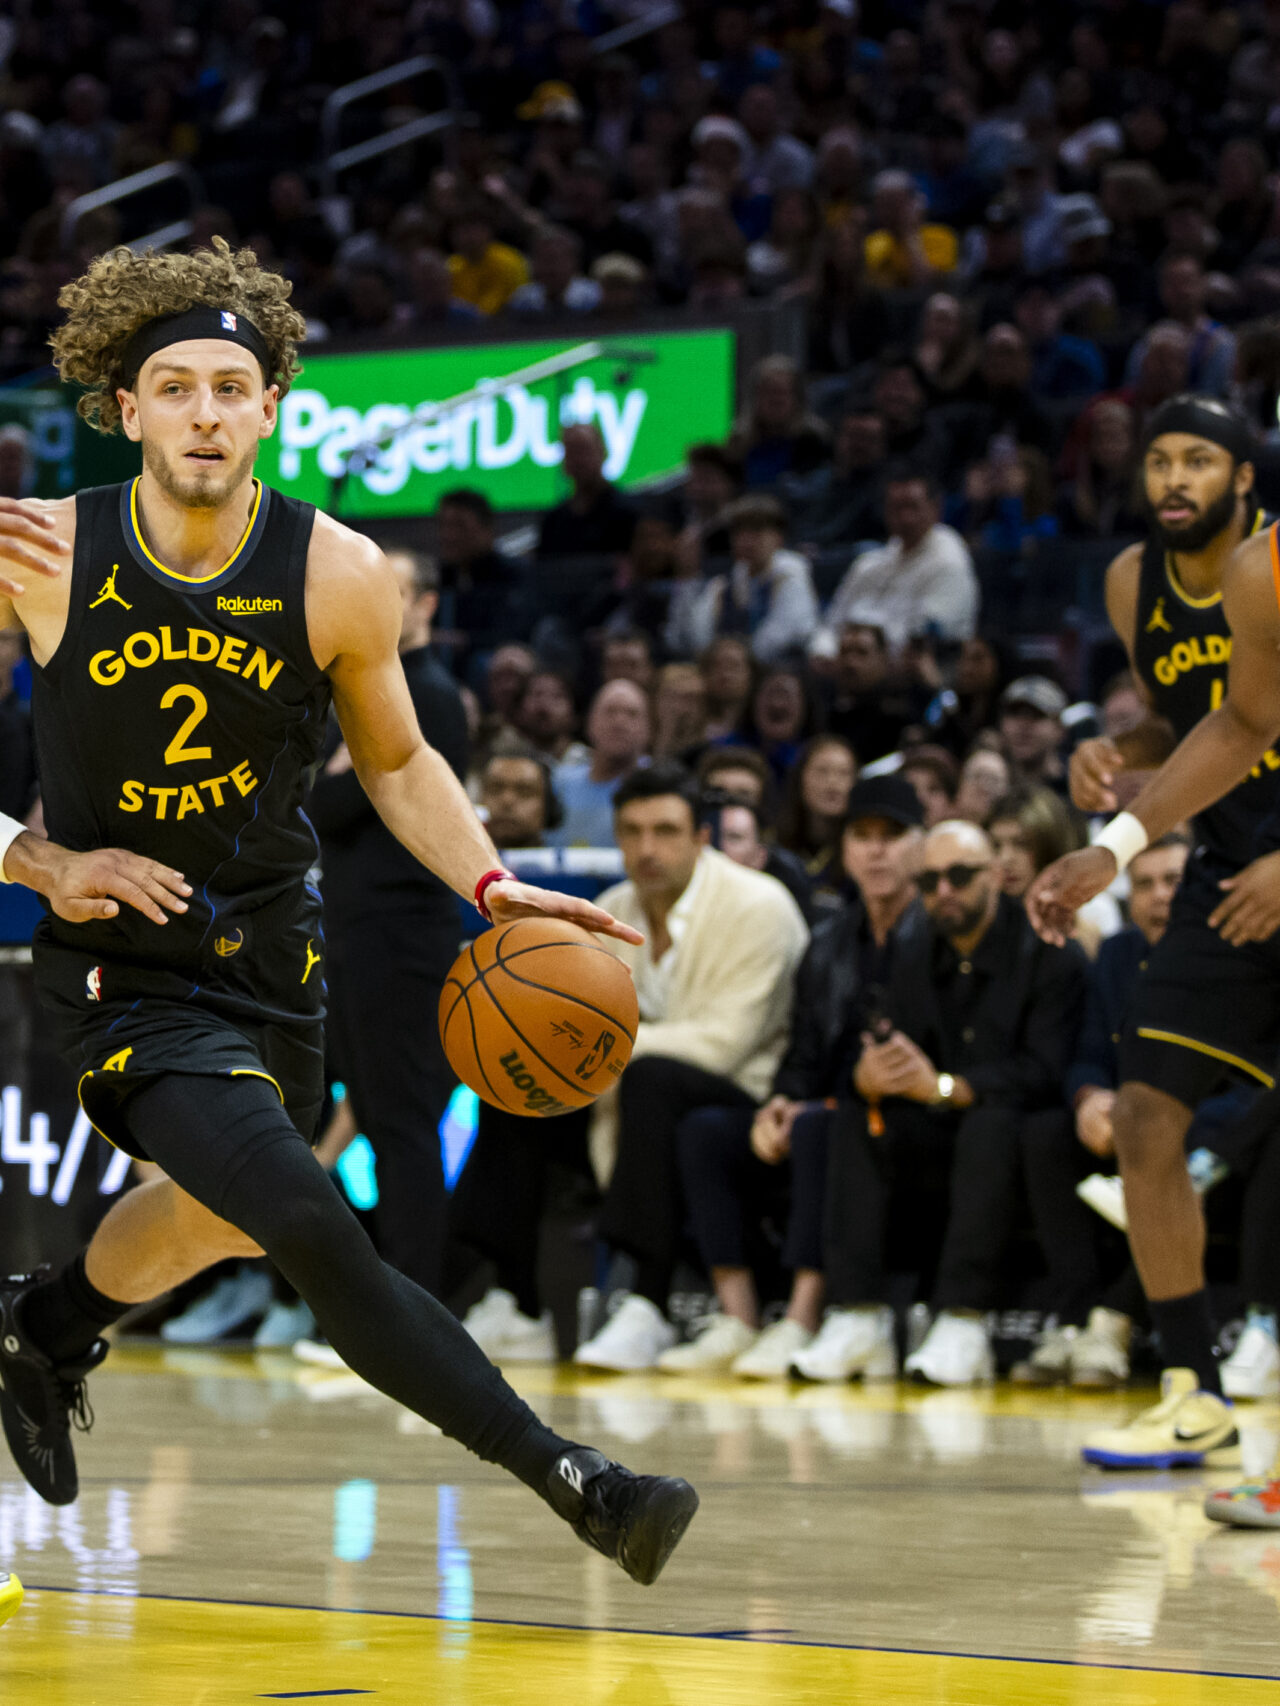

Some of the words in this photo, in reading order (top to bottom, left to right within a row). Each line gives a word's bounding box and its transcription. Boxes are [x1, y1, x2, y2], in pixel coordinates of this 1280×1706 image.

[216, 596, 283, 612] Rakuten
[88, 626, 285, 691] GOLDEN
[160, 684, 212, 765] 2
[118, 759, 258, 820] STATE
